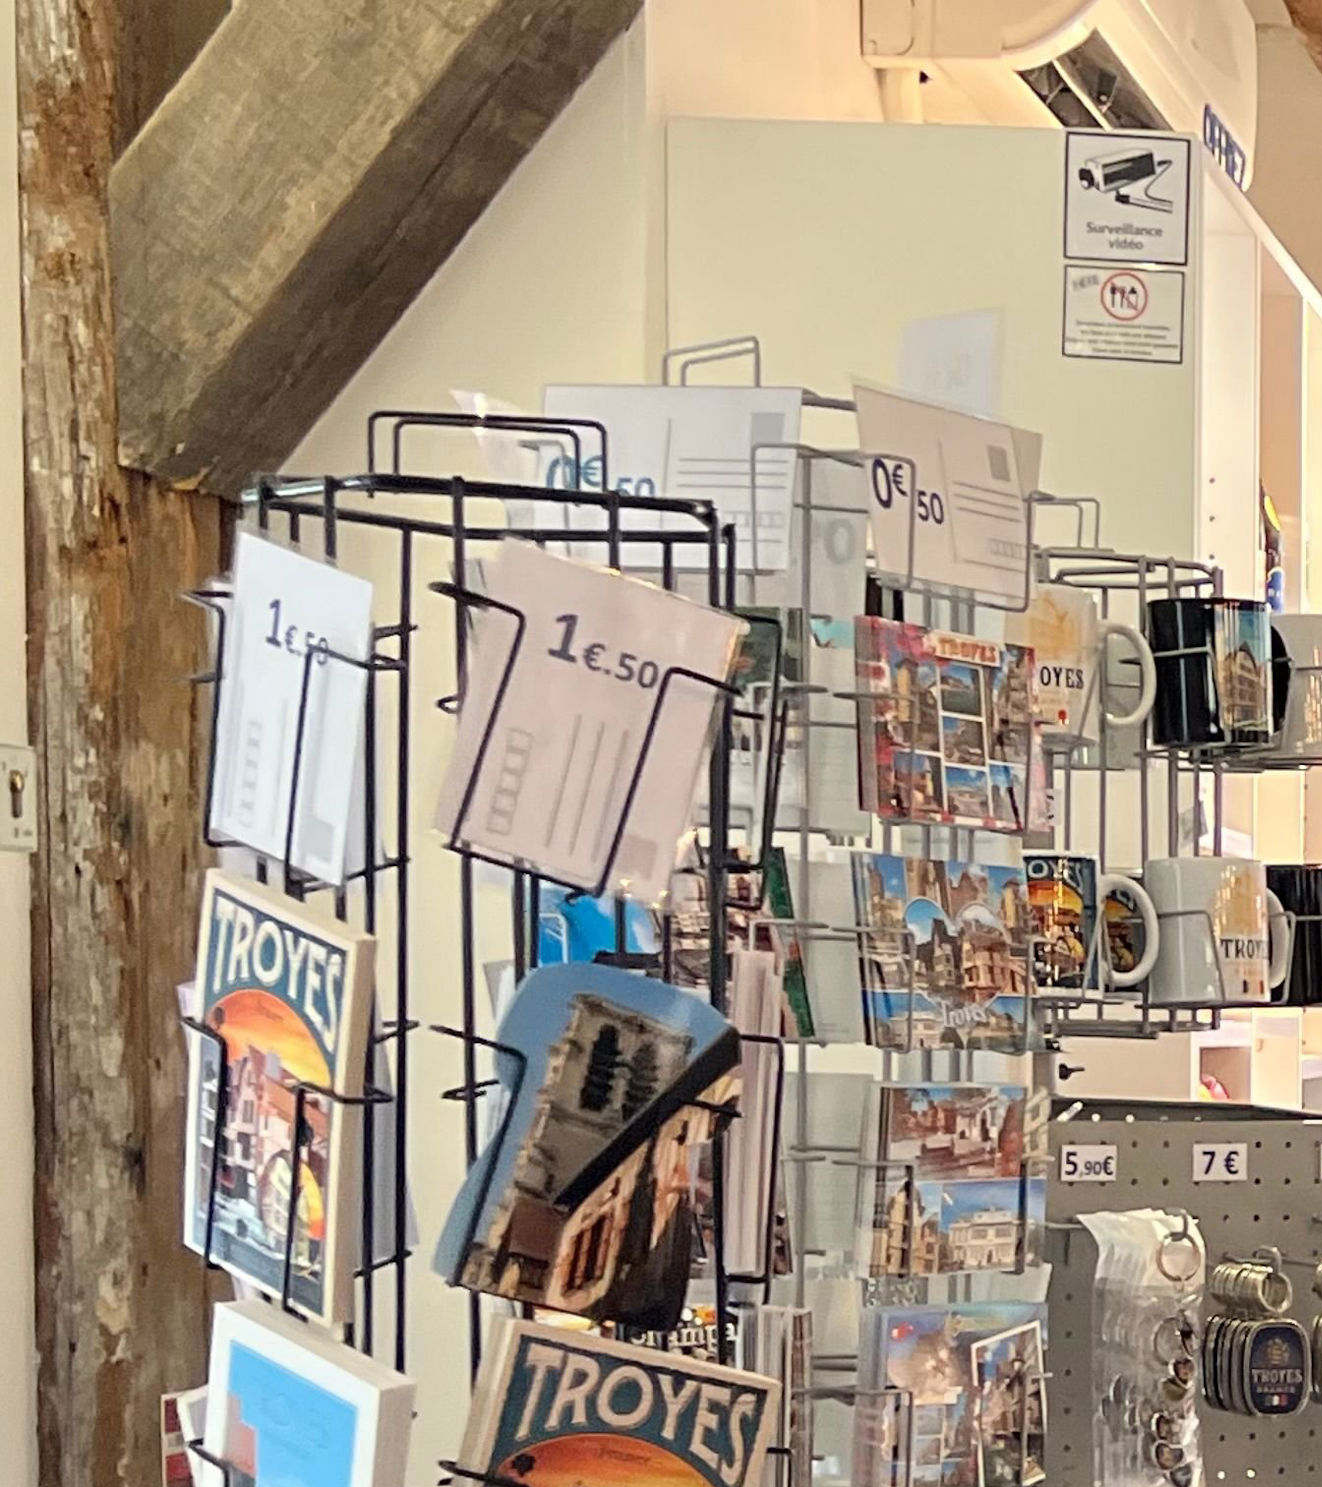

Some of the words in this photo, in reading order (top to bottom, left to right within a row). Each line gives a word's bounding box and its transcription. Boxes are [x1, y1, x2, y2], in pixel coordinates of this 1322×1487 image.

[1086, 221, 1163, 237] Surveillance
[1108, 238, 1144, 250] vidéo
[547, 614, 660, 689] 1€.50
[210, 902, 346, 1053] TROYES
[1064, 1150, 1115, 1177] 5,90€
[1251, 1369, 1302, 1383] TROYES
[514, 1343, 757, 1487] TROYES
